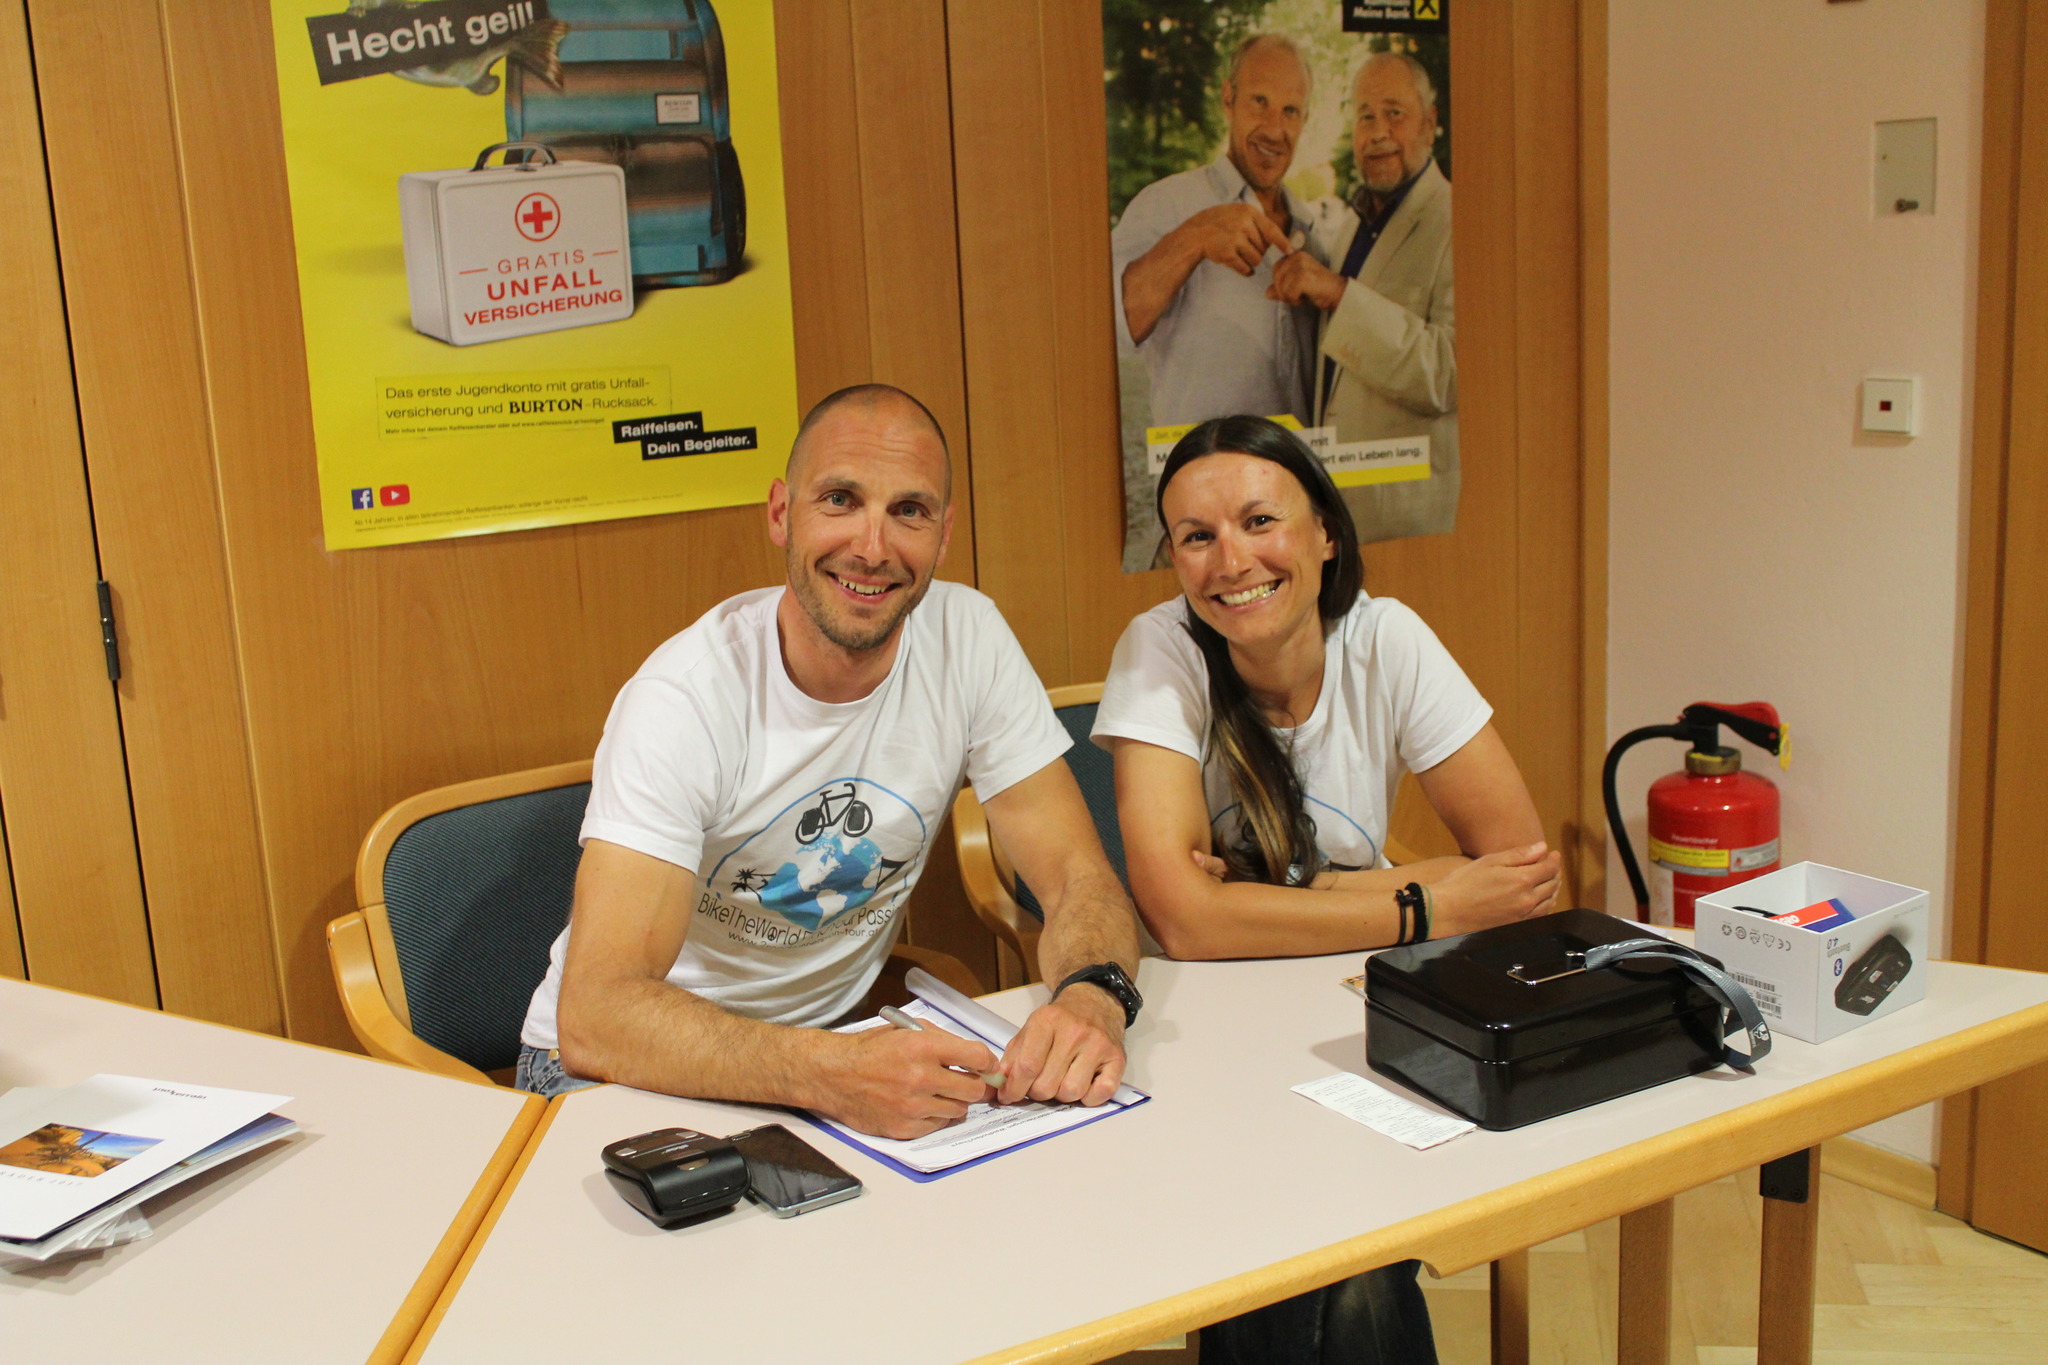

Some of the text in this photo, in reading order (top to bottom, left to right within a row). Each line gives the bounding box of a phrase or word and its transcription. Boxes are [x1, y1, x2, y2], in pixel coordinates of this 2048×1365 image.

[1353, 6, 1411, 19] Meine Bank
[326, 0, 535, 66] Hecht geil!
[497, 249, 585, 274] GRATIS
[487, 268, 603, 301] UNFALL
[464, 289, 623, 326] VERSICHERUNG
[386, 377, 650, 399] Das erste Jugendkonto mit gratis Unfall-
[386, 405, 474, 419] versicherung
[478, 403, 503, 415] und
[509, 398, 583, 414] BURTON
[620, 419, 698, 438] Raiffeisen.
[647, 435, 750, 455] Dein Begleiter.
[1310, 437, 1329, 446] mit
[1338, 452, 1356, 462] ein
[1360, 449, 1394, 461] Leben
[1396, 446, 1423, 458] lang.
